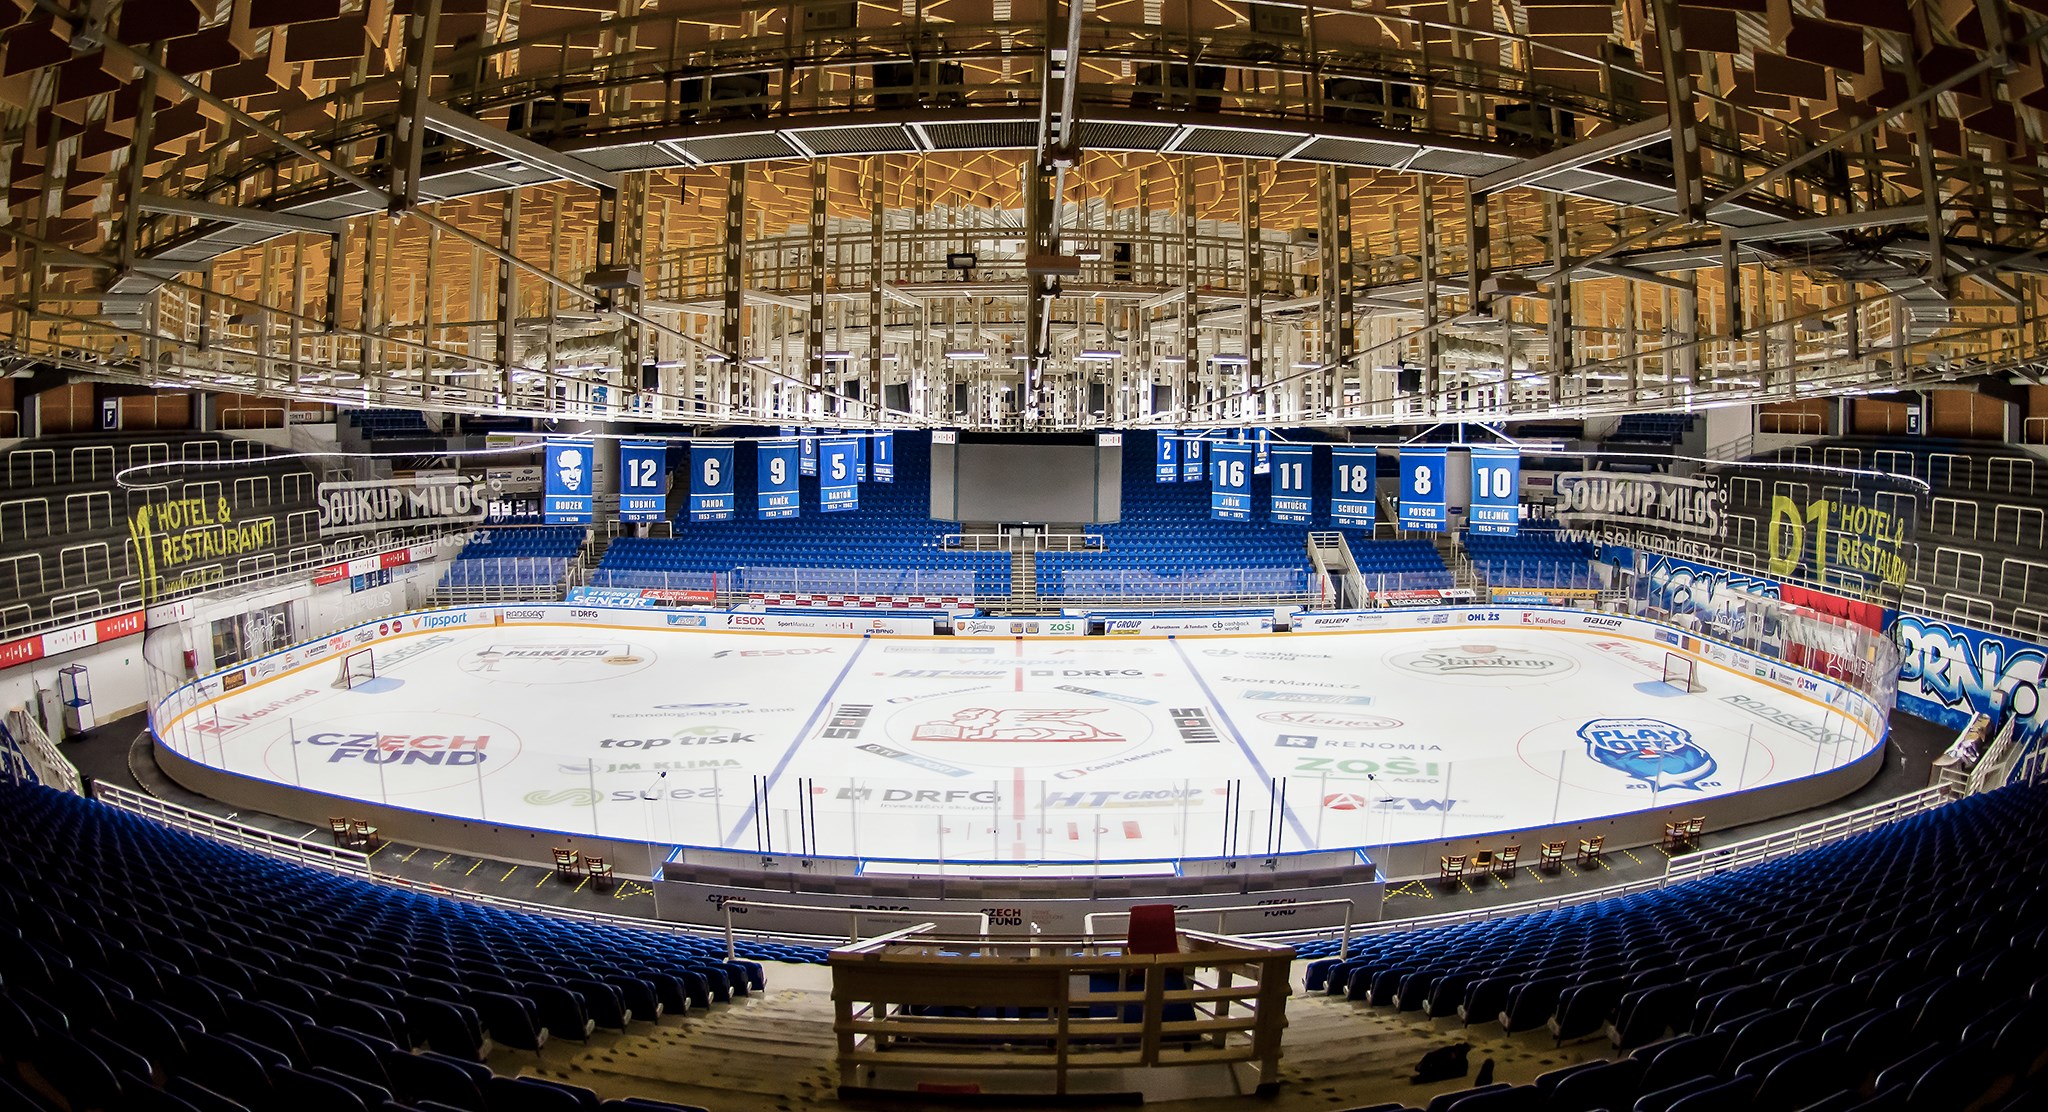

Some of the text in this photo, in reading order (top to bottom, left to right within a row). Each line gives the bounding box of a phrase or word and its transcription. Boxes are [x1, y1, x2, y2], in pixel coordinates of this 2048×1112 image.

[107, 410, 113, 422] F
[1911, 416, 1917, 427] E
[880, 441, 886, 459] 1
[1163, 442, 1171, 460] 2
[1187, 441, 1200, 459] 19
[628, 459, 657, 487] 12
[704, 458, 720, 486] 6
[770, 458, 785, 485] 9
[832, 454, 846, 480] 5
[1218, 460, 1244, 487] 16
[1280, 463, 1302, 489] 11
[1339, 465, 1367, 493] 18
[1414, 466, 1431, 495] 8
[1477, 467, 1511, 498] 10
[318, 475, 489, 527] SOUKUP MILOŠ
[555, 501, 583, 510] BOUZEK
[629, 498, 656, 509] BUBNÍK
[1556, 474, 1718, 536] SOUKUP MILOŠ
[156, 497, 231, 531] HOTEL &
[1338, 504, 1368, 515] SCHEUER
[1409, 507, 1436, 517] POTSCH
[1478, 510, 1510, 521] OLEJNÍK
[1841, 504, 1904, 549] HOTEL &
[162, 521, 274, 567] RESTAURANT
[573, 596, 650, 607] SENCOR
[423, 612, 467, 629] Tipsport
[506, 610, 546, 620] RADEGAST
[578, 610, 598, 618] DRFG
[736, 616, 765, 626] ESOX
[1314, 617, 1350, 625] BAUER
[1467, 611, 1500, 621] OHL ŽS
[1535, 617, 1566, 625] Kaufland
[778, 620, 815, 628] SportMania.cz
[1050, 621, 1075, 631] ZOŠI
[1116, 620, 1142, 629] GROUP
[1212, 621, 1223, 629] cb
[1583, 616, 1622, 627] BAUER
[329, 635, 343, 646] OMNI
[335, 640, 351, 651] PLAST
[740, 647, 836, 657] ESOX
[893, 669, 950, 678] HT
[1220, 675, 1361, 689] SportMania.cz
[236, 688, 320, 721] Kaufland
[600, 732, 756, 750] top tisk
[1591, 729, 1681, 747] PLAY
[1324, 740, 1443, 752] RENOMIA
[1607, 739, 1677, 753] OFF
[327, 749, 487, 766] FUND
[607, 758, 741, 773] JM KLIMA
[1294, 755, 1439, 777] ZOŠI
[611, 787, 723, 801] suez
[882, 789, 1002, 803] DRFG
[1045, 788, 1204, 807] HT GROUP
[989, 917, 1022, 926] FUND
